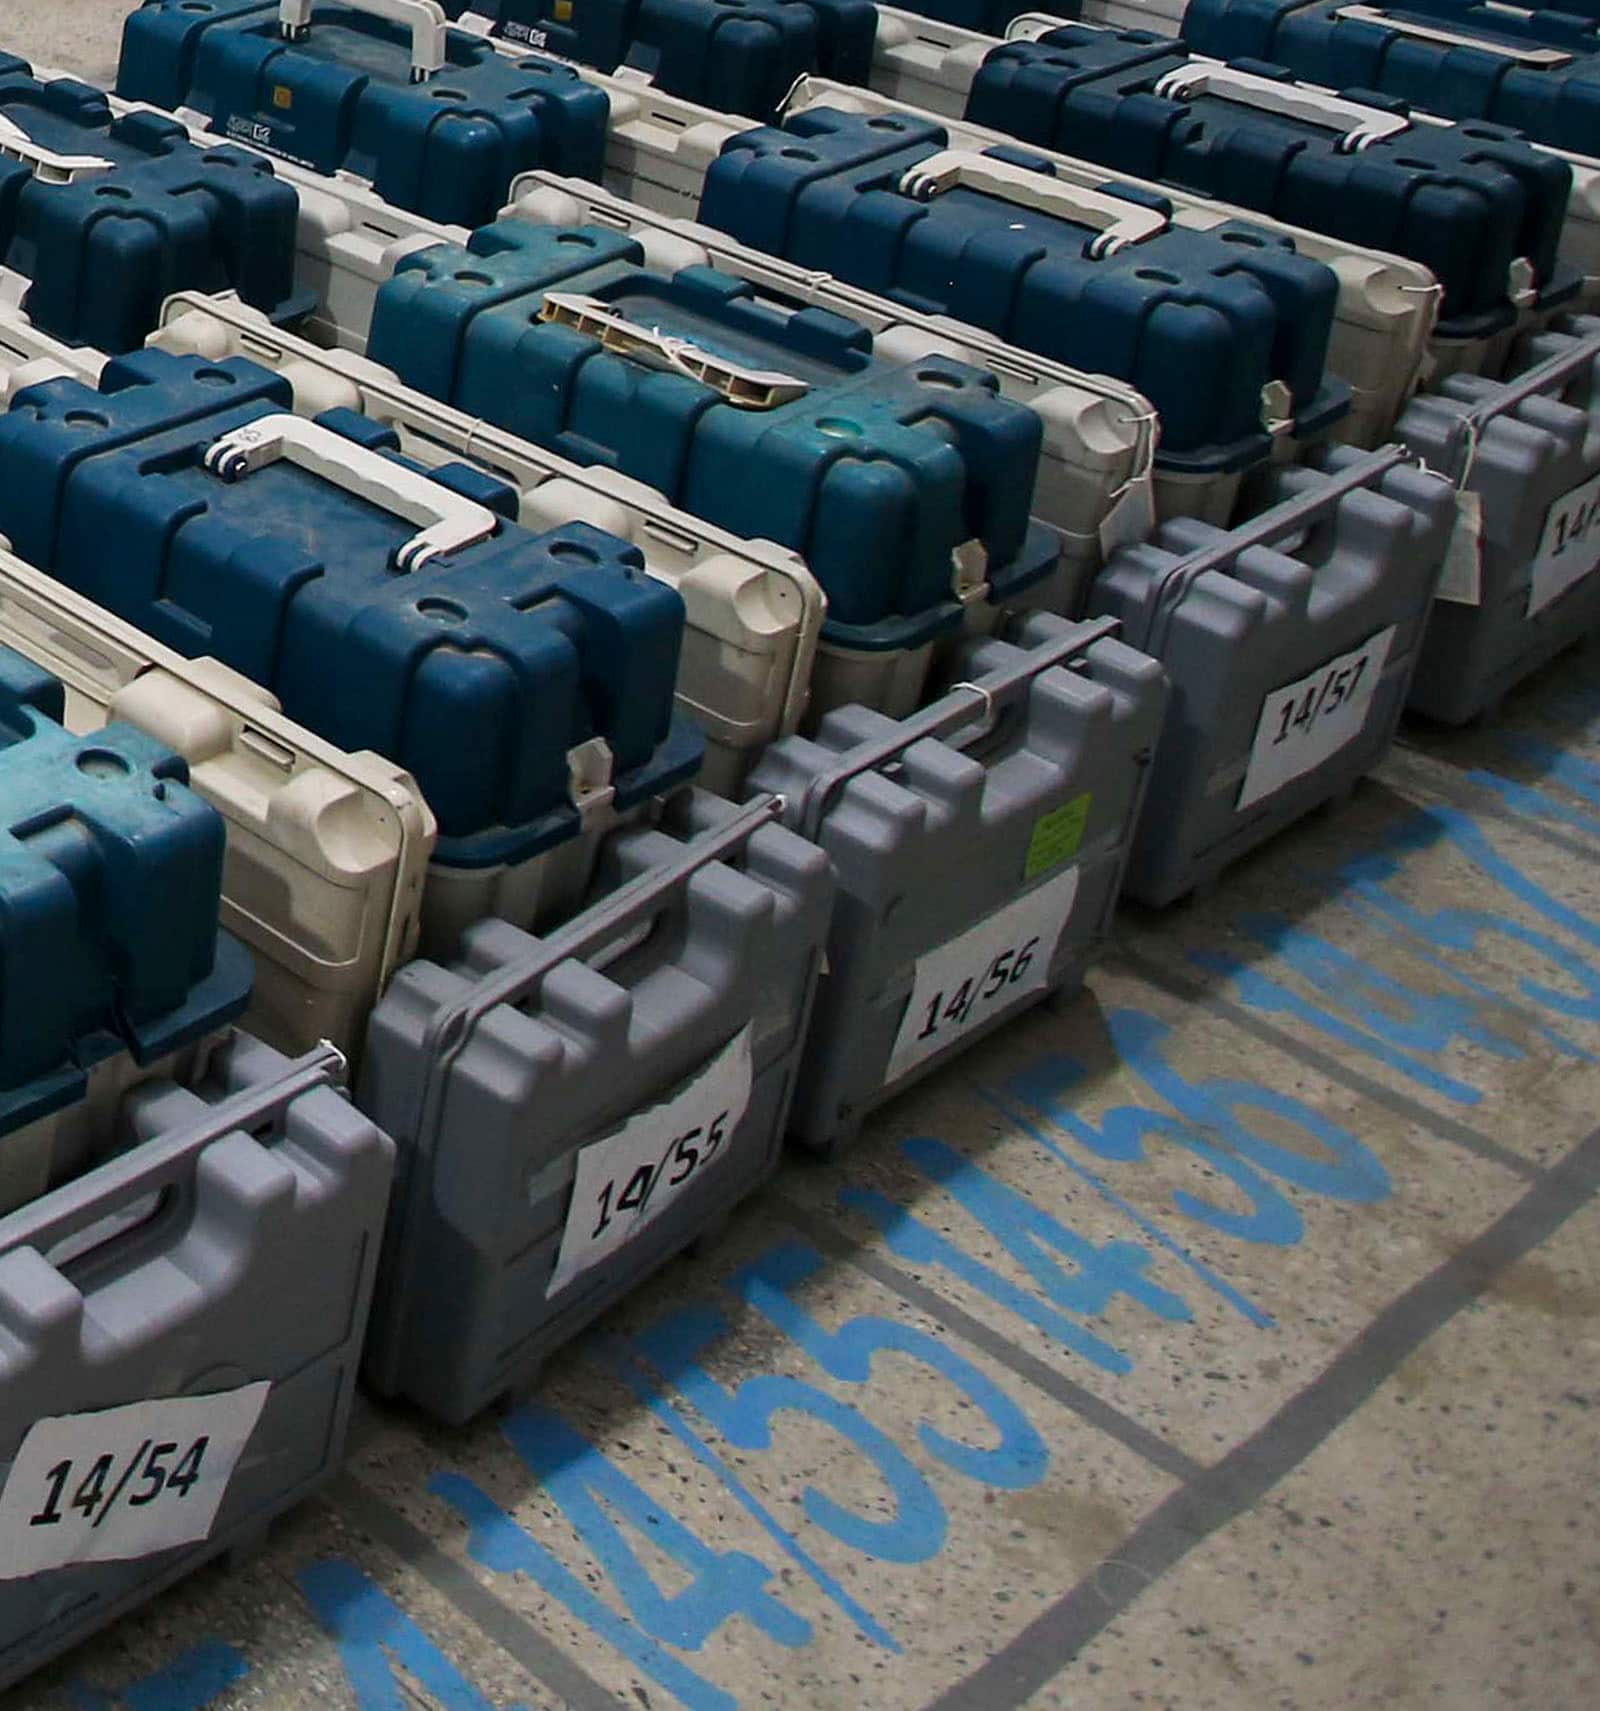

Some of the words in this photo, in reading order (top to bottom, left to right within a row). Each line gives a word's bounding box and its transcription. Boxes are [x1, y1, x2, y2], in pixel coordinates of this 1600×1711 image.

[1271, 652, 1370, 747] 14/57
[916, 934, 1041, 1043] 14/56
[590, 1109, 729, 1243] 14/55
[836, 1007, 1394, 1377] 14/56
[29, 1431, 212, 1530] 14/54
[427, 1240, 1050, 1711] 14/55
